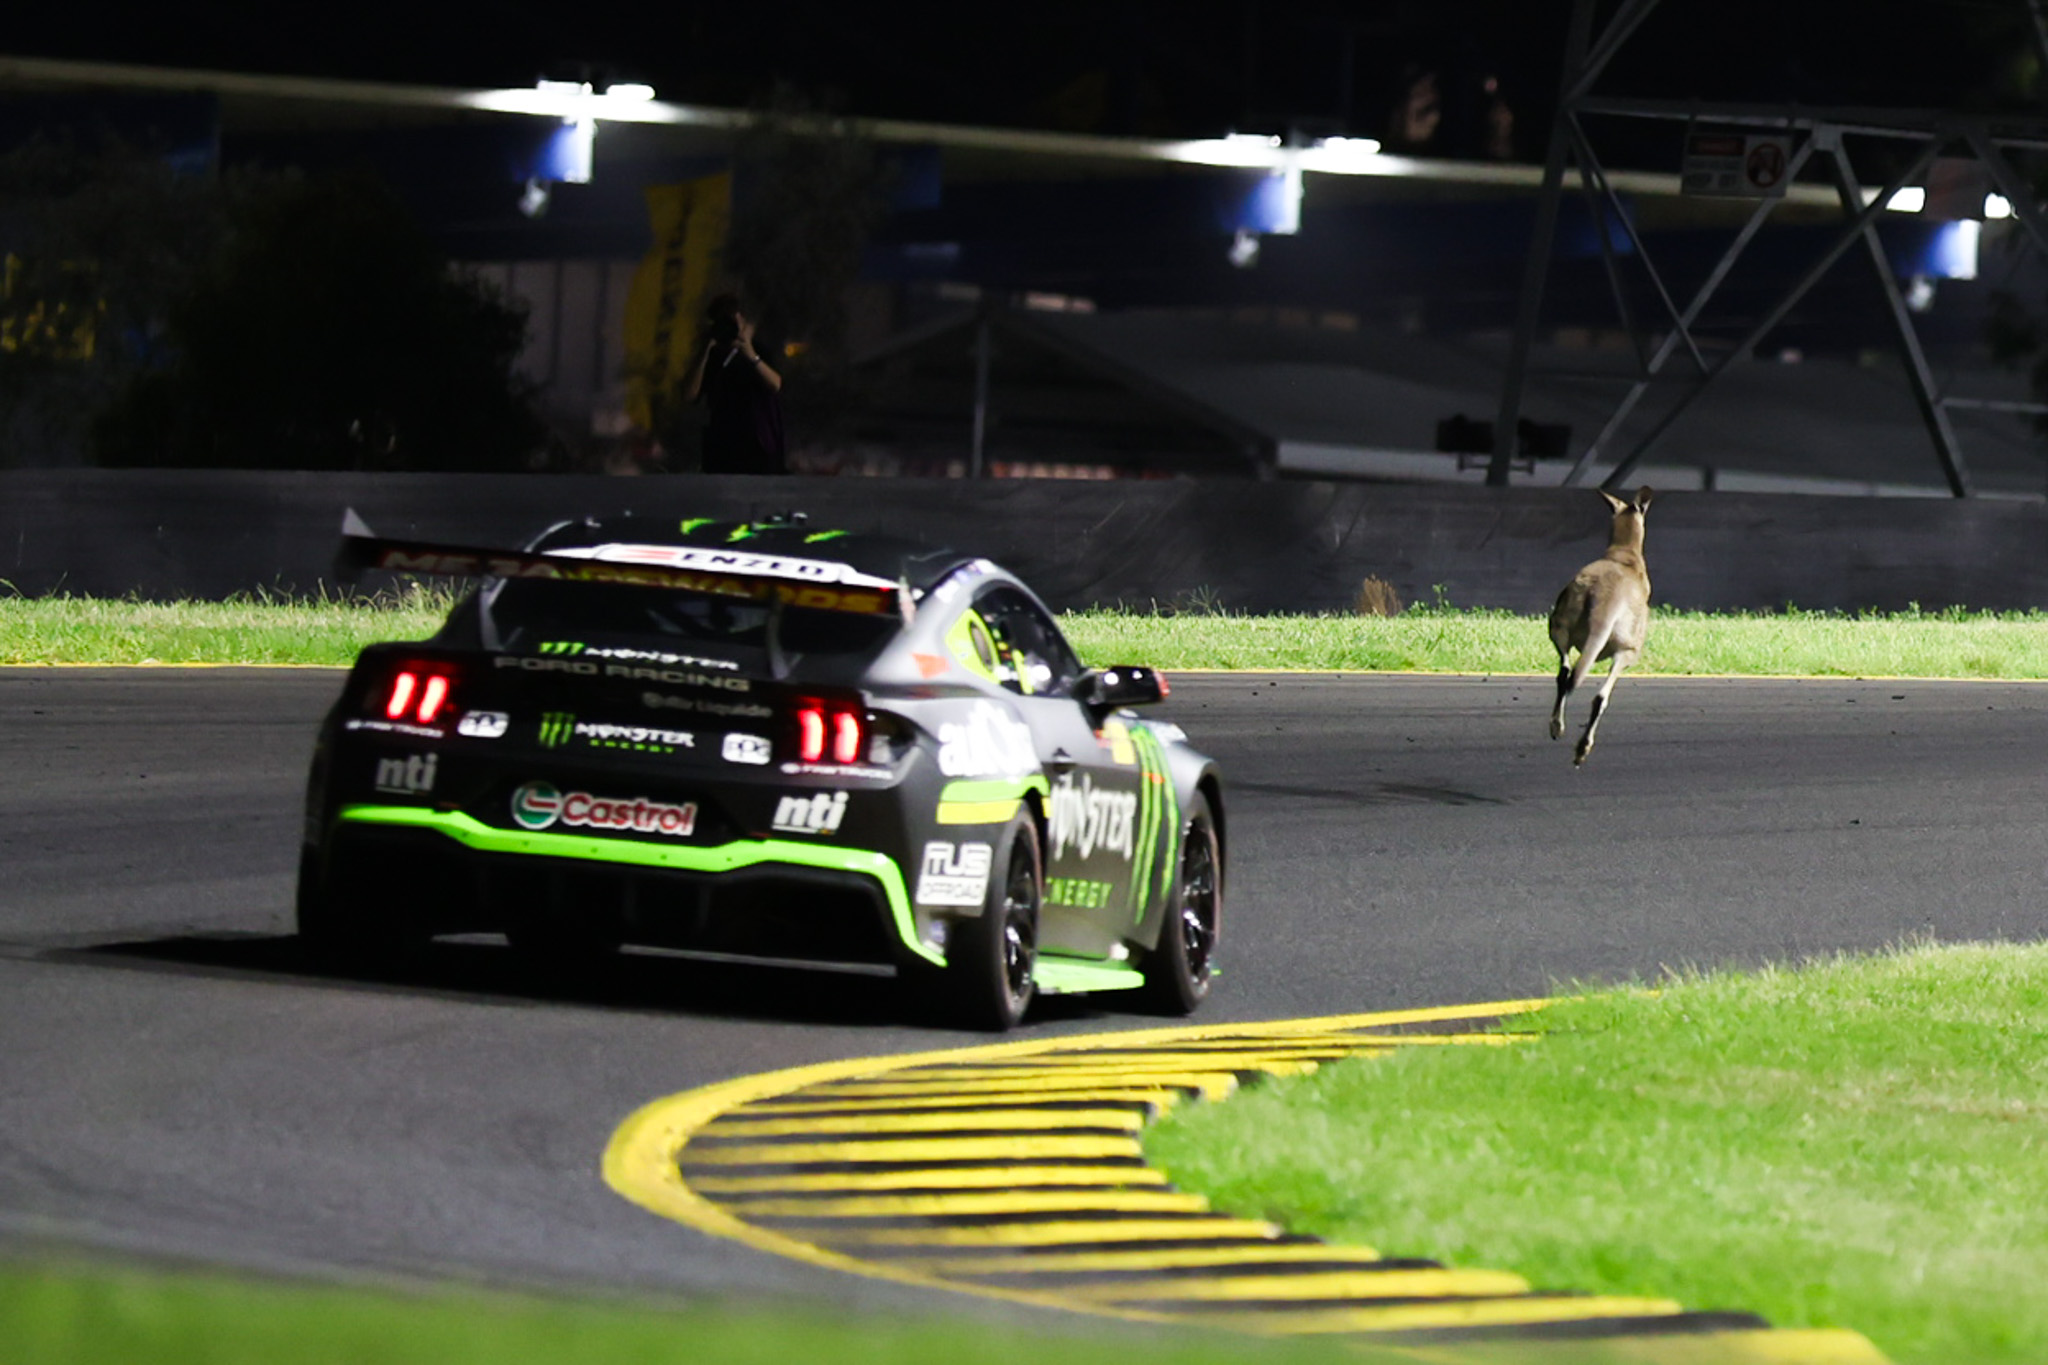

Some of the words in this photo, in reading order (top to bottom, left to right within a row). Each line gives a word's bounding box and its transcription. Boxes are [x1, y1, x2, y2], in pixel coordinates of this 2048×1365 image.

[677, 551, 827, 577] ENZED
[494, 656, 599, 676] FORD
[605, 663, 750, 692] RACING
[584, 647, 739, 671] MONSTER
[575, 722, 696, 748] MONSTER
[376, 752, 439, 791] nti
[561, 793, 697, 835] Castrol
[774, 791, 849, 830] nti
[1047, 771, 1137, 861] ONSTER
